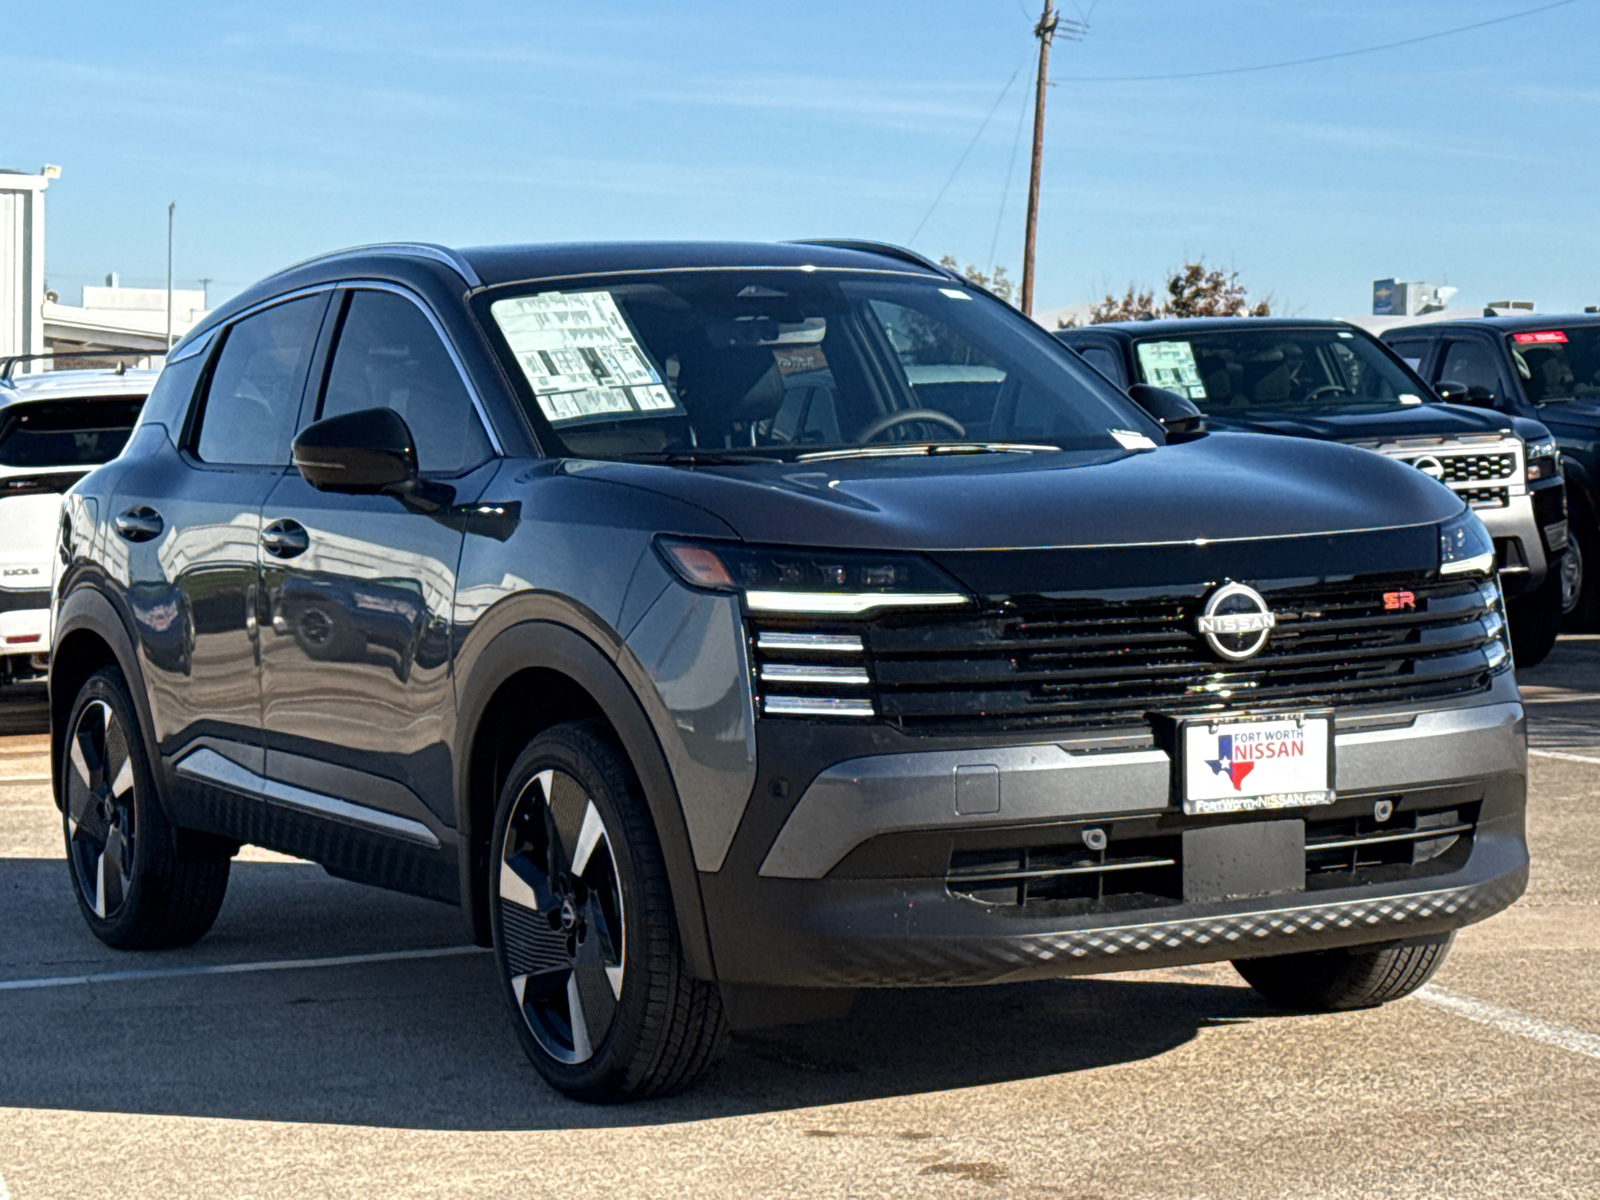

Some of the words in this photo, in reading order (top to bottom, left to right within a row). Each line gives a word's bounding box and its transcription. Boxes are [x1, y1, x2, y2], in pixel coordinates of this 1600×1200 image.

[1383, 592, 1415, 610] SR
[1200, 615, 1275, 632] NISSAN
[1234, 732, 1261, 743] FORT
[1264, 729, 1304, 741] WORTH
[1234, 740, 1304, 760] NISSAN
